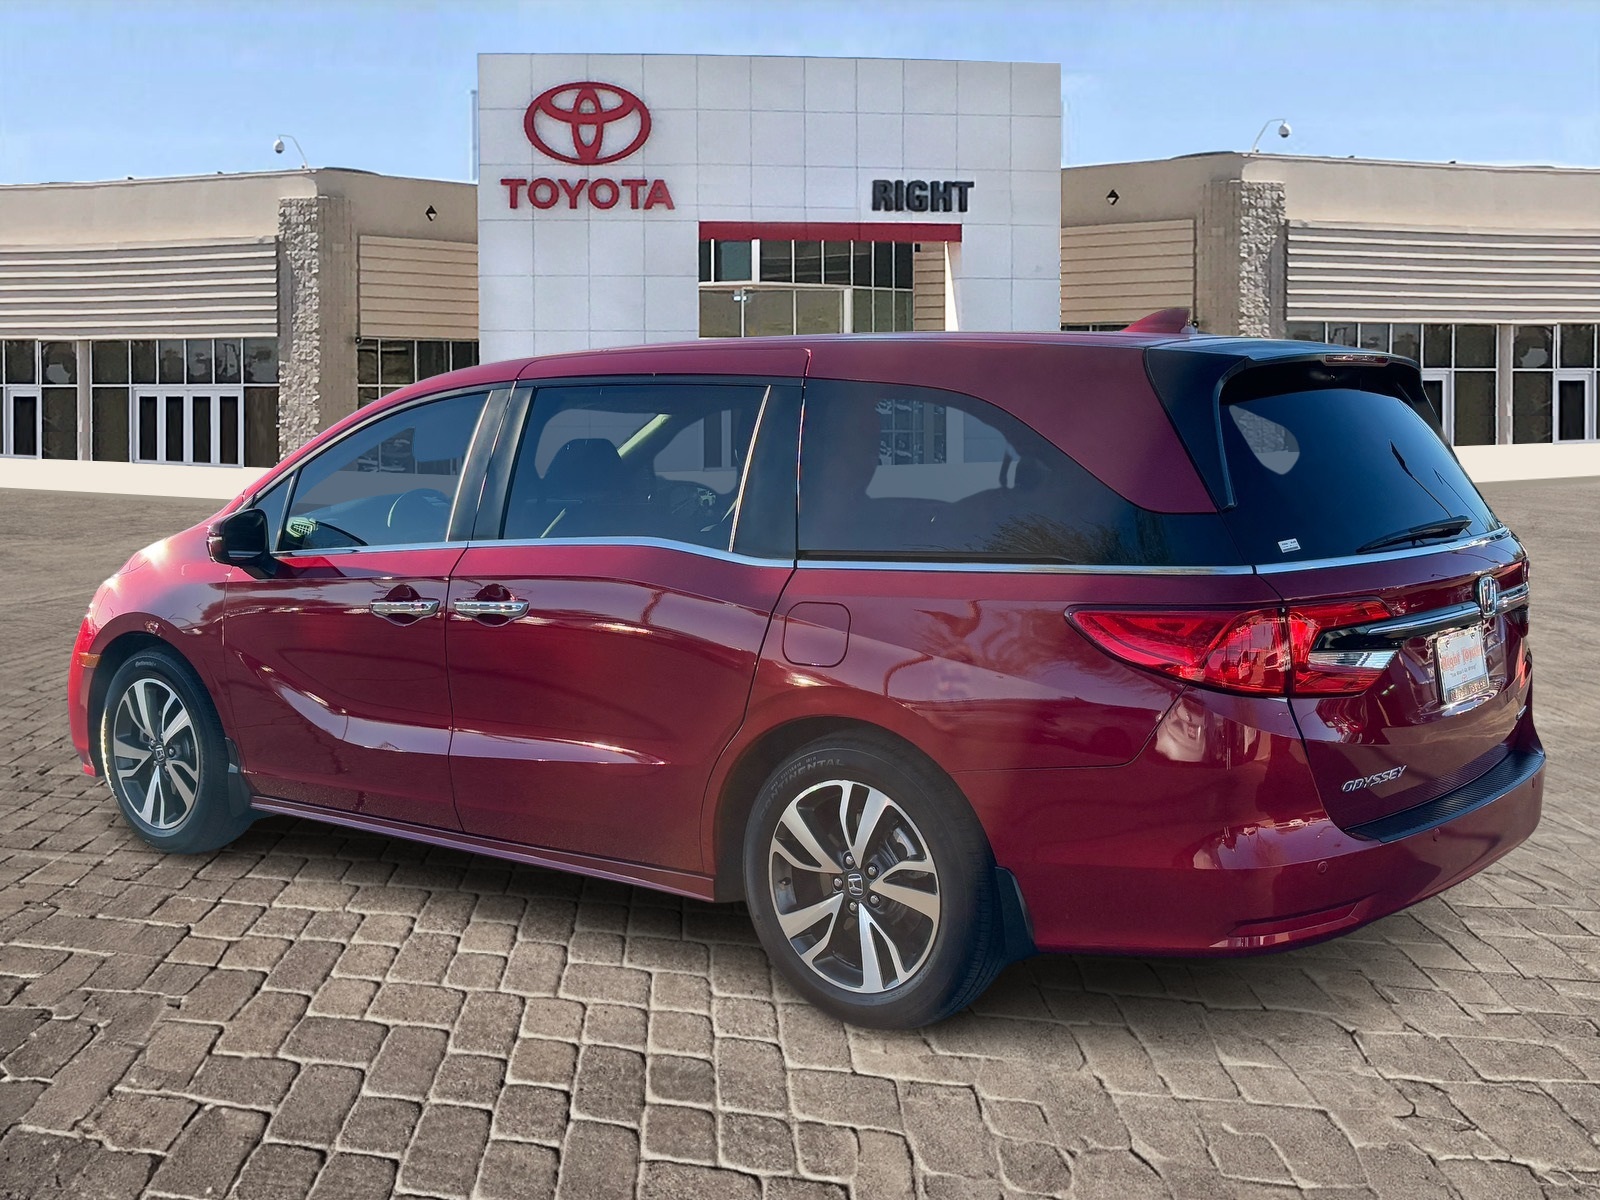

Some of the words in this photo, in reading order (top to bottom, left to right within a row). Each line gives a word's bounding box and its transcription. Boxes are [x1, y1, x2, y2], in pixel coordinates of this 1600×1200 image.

[500, 178, 675, 210] TOYOTA
[871, 179, 975, 213] RIGHT
[1342, 765, 1407, 792] ODYSSEY
